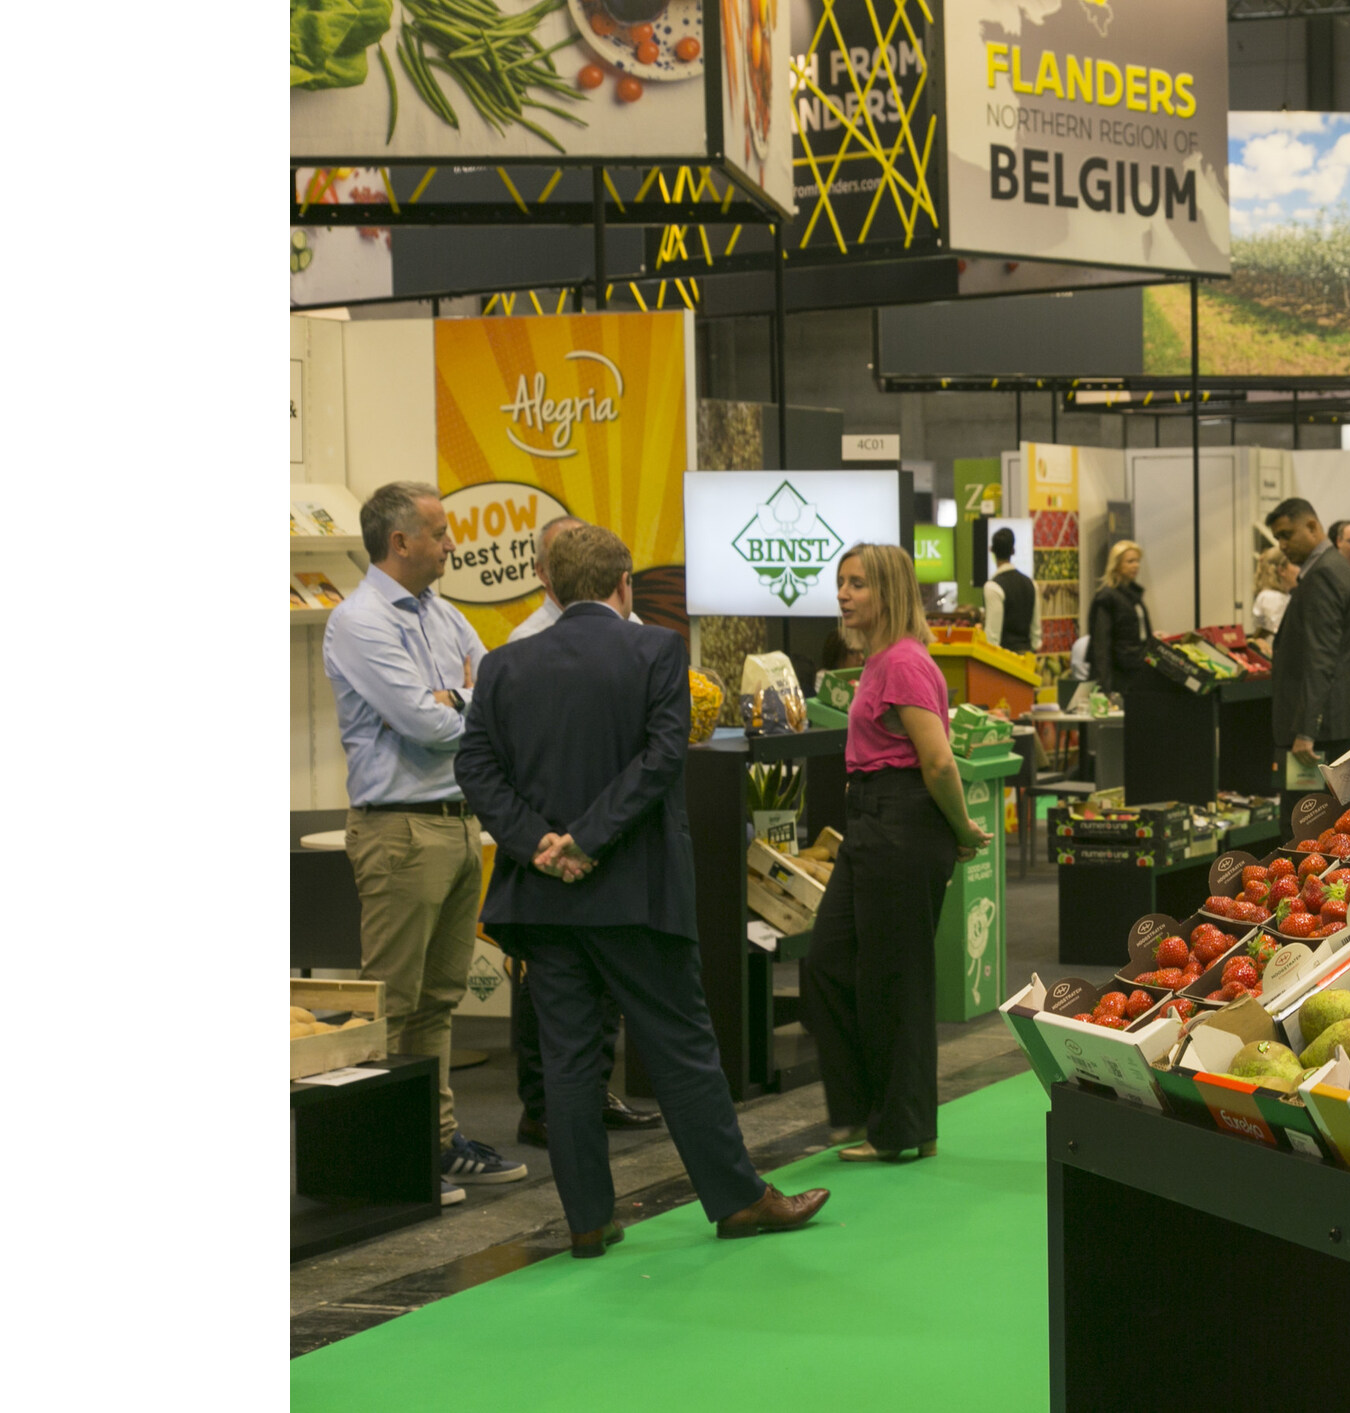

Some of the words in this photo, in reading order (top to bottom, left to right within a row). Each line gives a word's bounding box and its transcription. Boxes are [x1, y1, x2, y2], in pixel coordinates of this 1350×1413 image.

[829, 37, 924, 86] FROM
[985, 40, 1197, 120] FLANDERS
[986, 101, 1093, 141] NORTHERN
[1099, 118, 1168, 152] REGION
[1173, 129, 1199, 155] OF
[989, 142, 1198, 223] BELGIUM
[500, 370, 619, 449] Alegria
[856, 438, 886, 451] 4C01
[446, 493, 539, 546] WOW
[450, 541, 503, 571] best
[509, 531, 537, 560] fri
[480, 556, 537, 587] ever!
[746, 537, 830, 563] BINST
